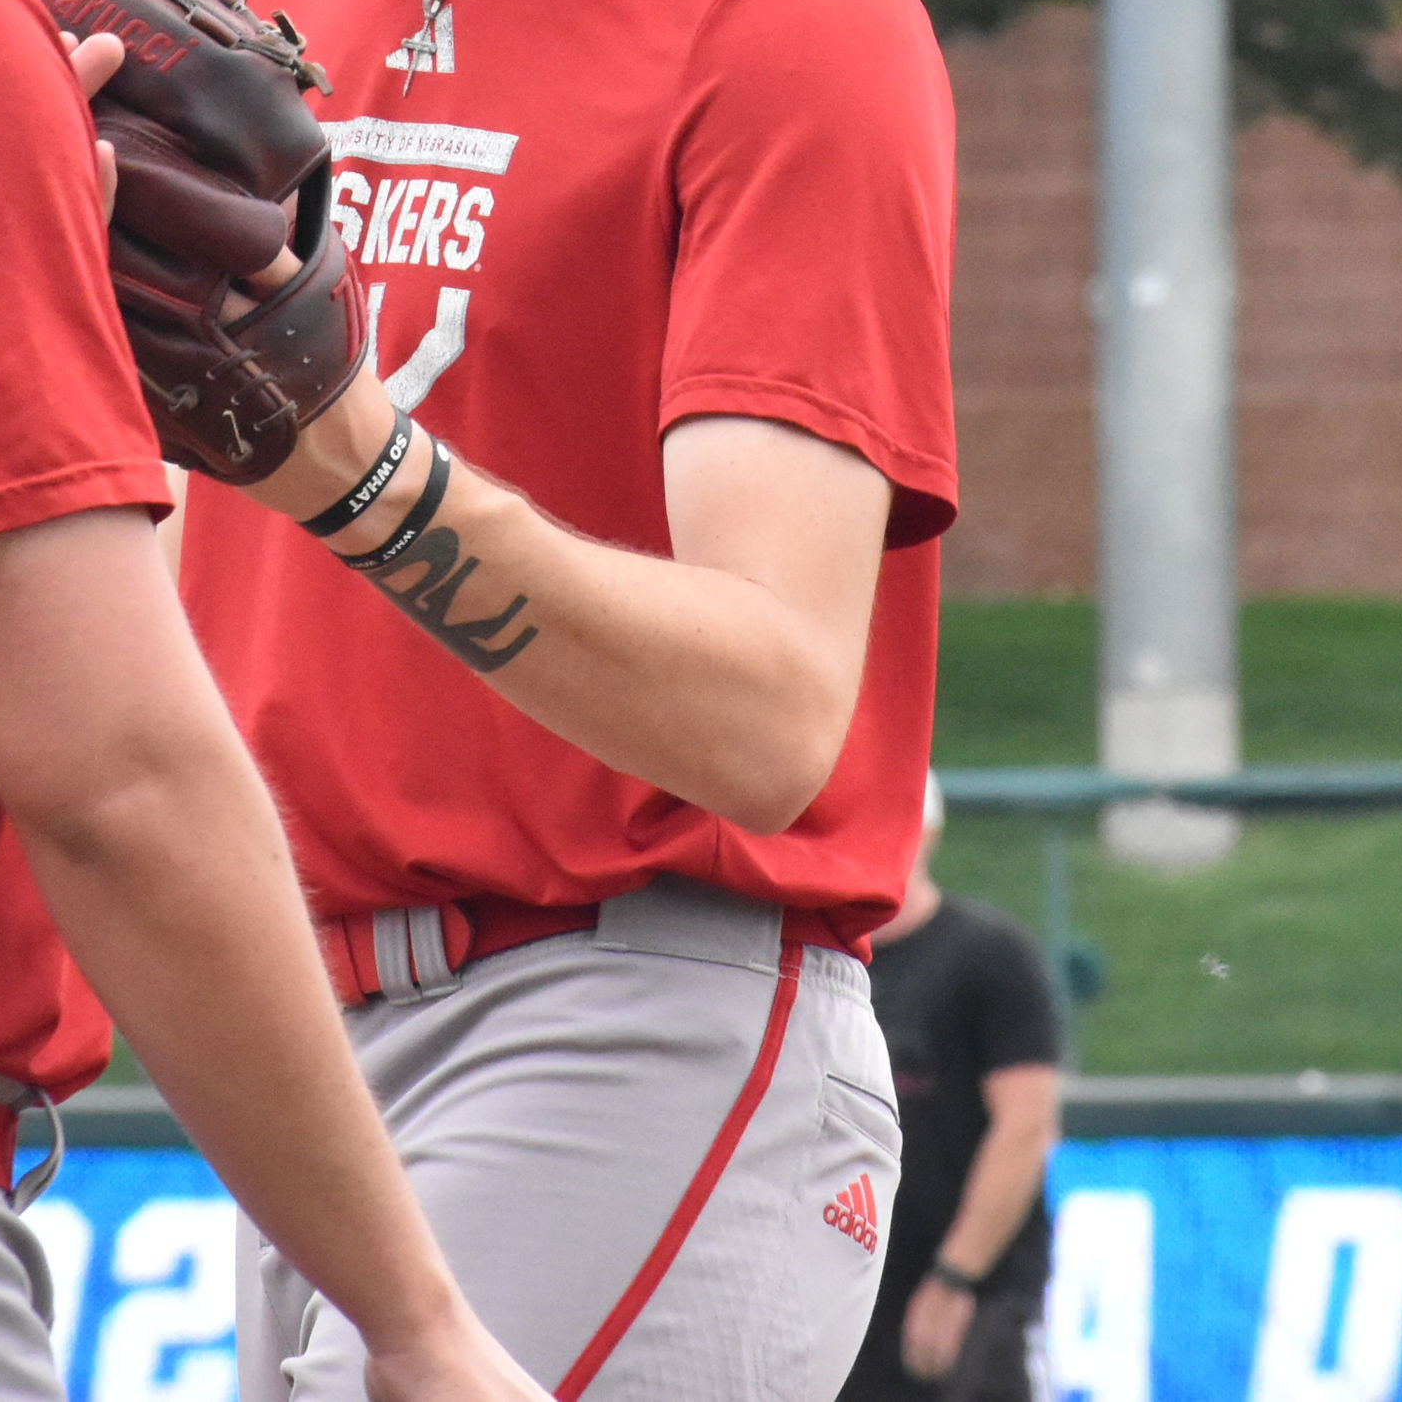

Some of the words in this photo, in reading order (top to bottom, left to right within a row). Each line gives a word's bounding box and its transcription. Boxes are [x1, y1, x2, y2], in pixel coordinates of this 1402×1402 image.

[331, 171, 494, 271] SKERS
[390, 433, 408, 460] SO
[348, 461, 394, 513] WHAT
[383, 530, 416, 561] WHAT
